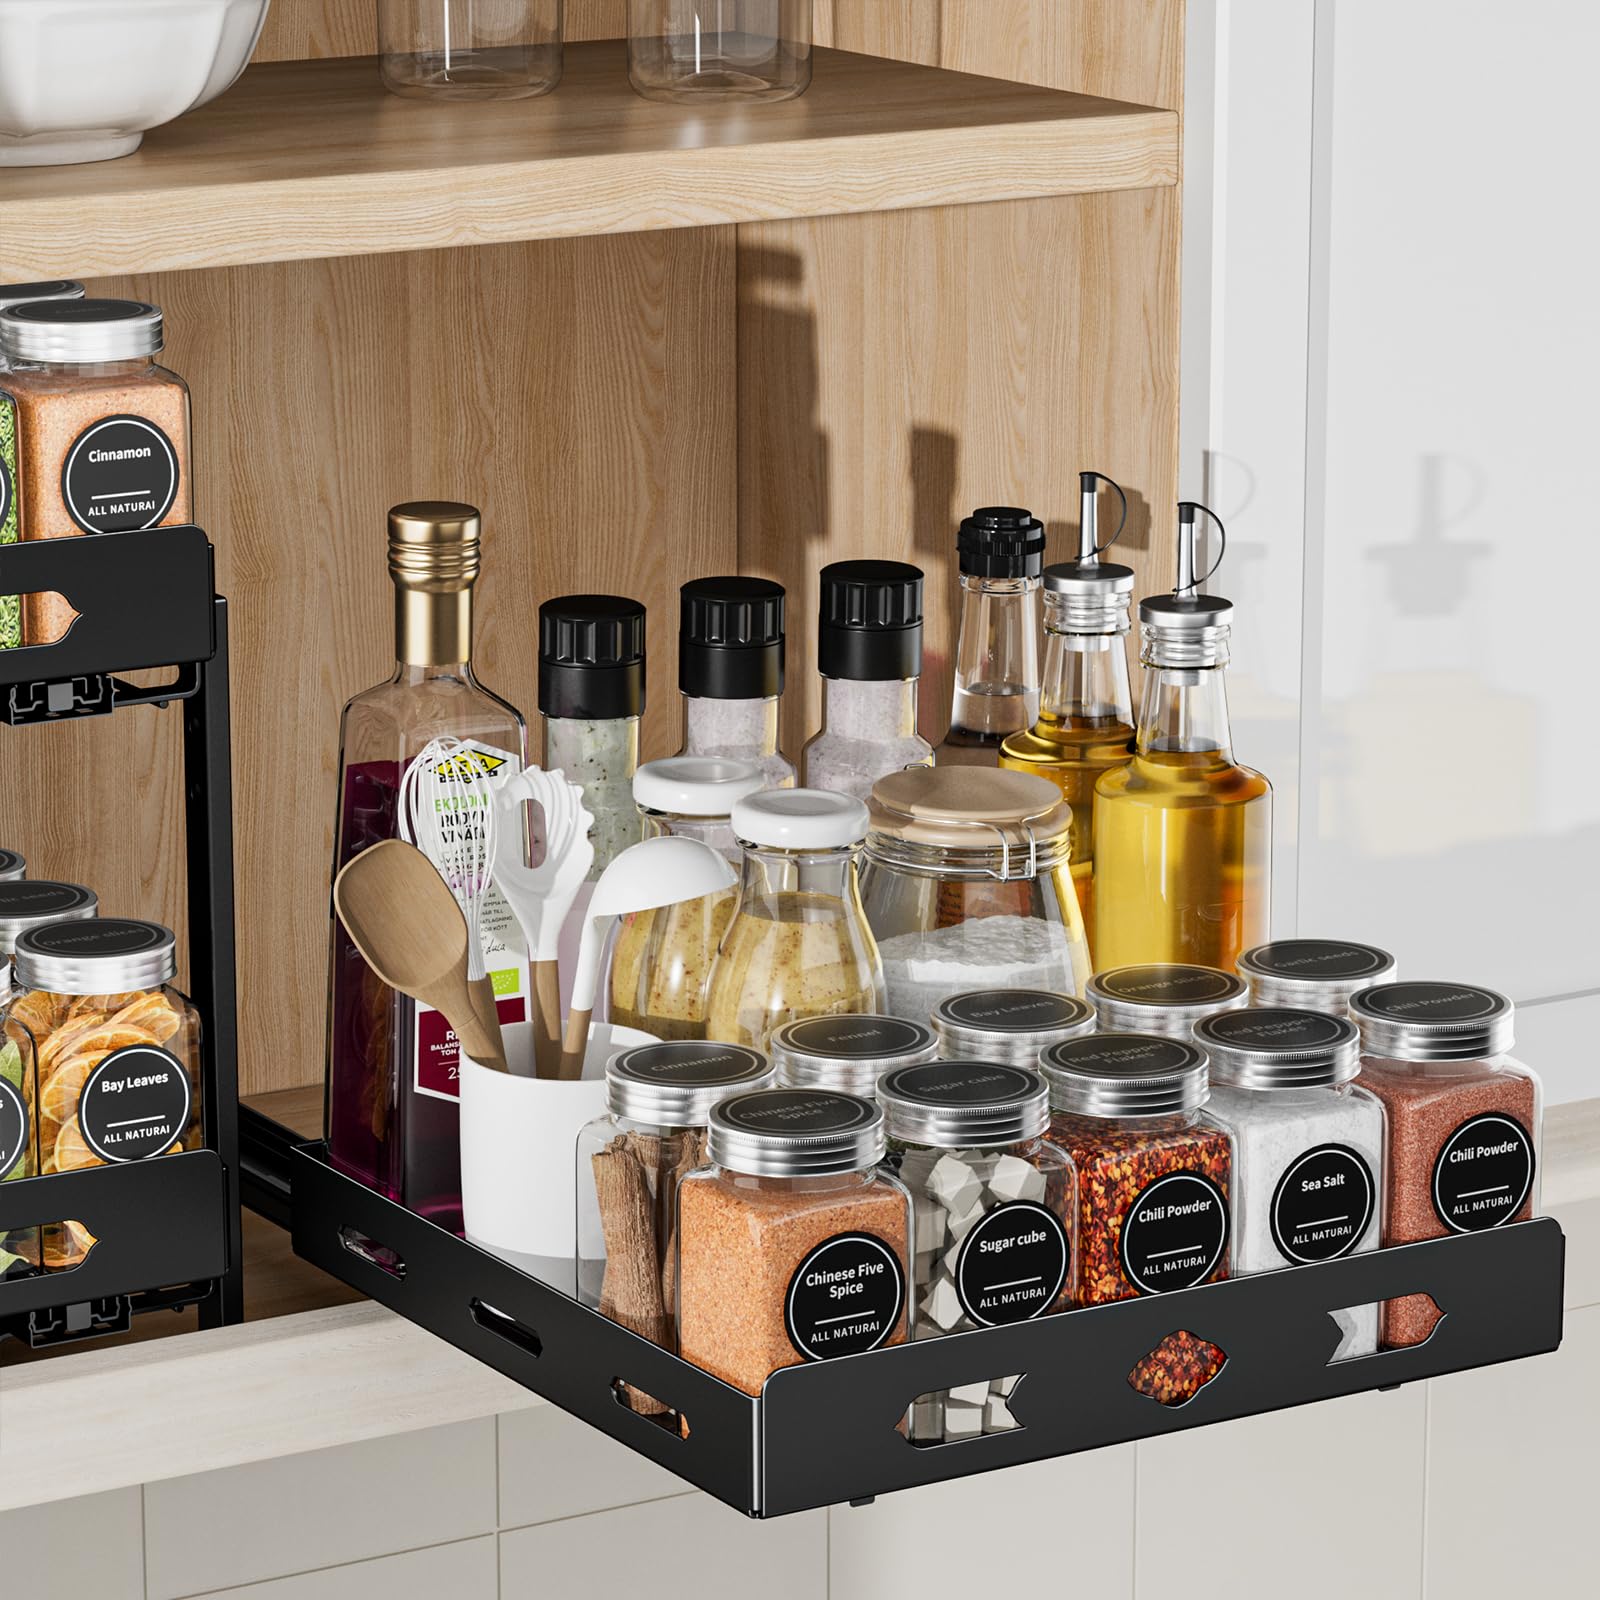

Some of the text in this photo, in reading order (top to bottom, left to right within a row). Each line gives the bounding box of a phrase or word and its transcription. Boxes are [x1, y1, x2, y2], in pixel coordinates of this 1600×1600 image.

[88, 446, 152, 463] Cinnamon
[88, 505, 107, 517] ALL
[1420, 992, 1475, 1006] Powder
[651, 1054, 733, 1072] Cinnamon
[101, 1072, 169, 1094] Bay Leaves
[103, 1132, 123, 1145] ALL
[1449, 1139, 1519, 1163] Chili Powder
[1301, 1173, 1346, 1192] Sea Salt
[1138, 1198, 1212, 1224] Chili Powder
[1453, 1203, 1471, 1215] ALL
[979, 1230, 1047, 1254] Sugar cube
[1292, 1233, 1310, 1245] ALL
[805, 1262, 885, 1287] Chinese Five
[1143, 1264, 1161, 1276] ALL
[829, 1281, 864, 1300] Spice
[979, 1296, 999, 1309] ALL
[810, 1331, 831, 1344] ALL
